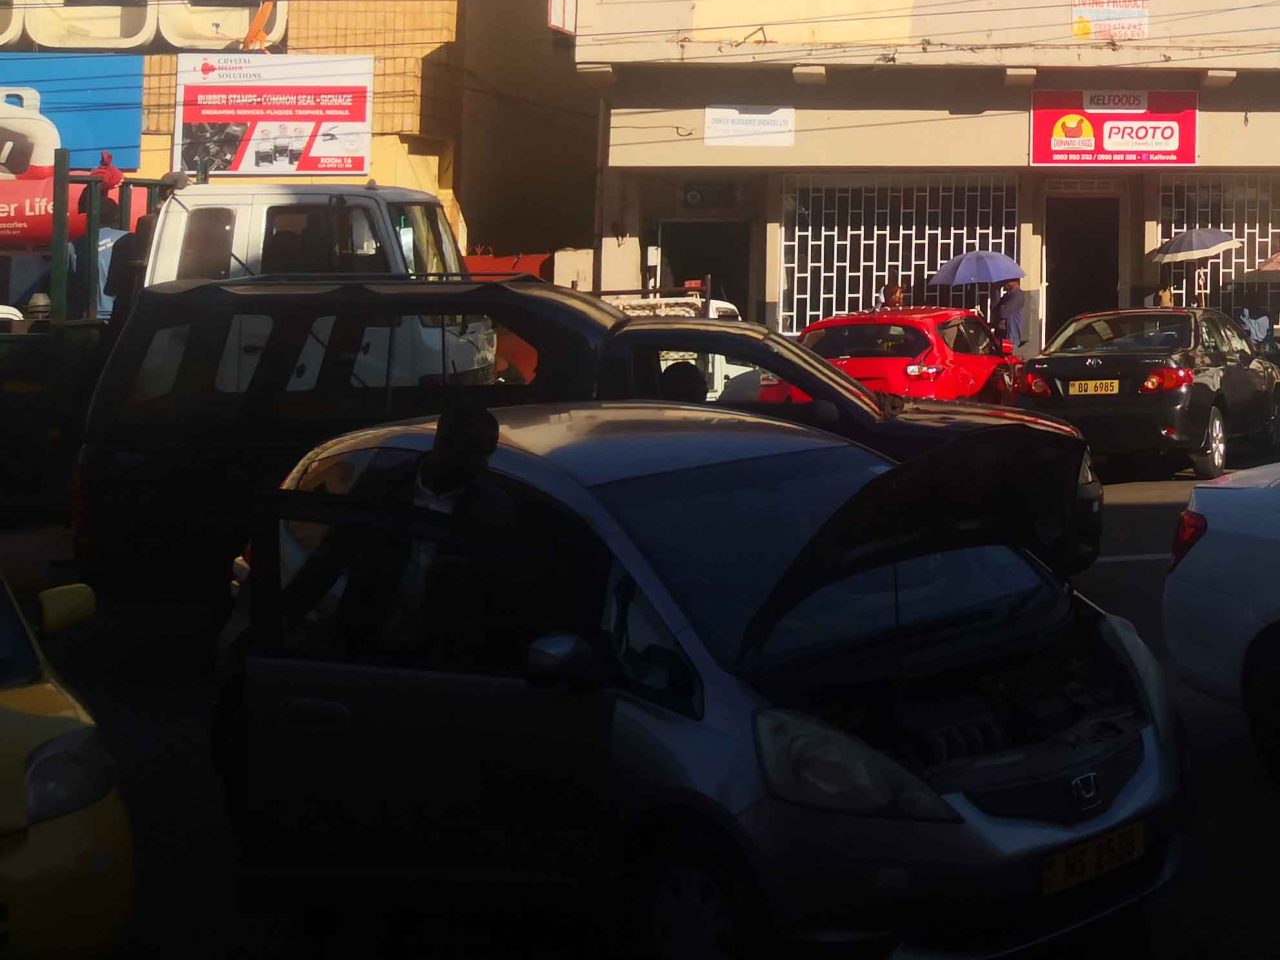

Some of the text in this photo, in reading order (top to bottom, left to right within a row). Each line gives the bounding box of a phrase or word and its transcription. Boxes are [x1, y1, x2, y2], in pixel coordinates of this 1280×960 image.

[197, 94, 353, 105] RUBBER STAMPS COMMON SEAL SIGNAGE
[1089, 94, 1141, 105] KELFOODS
[1108, 126, 1174, 140] PROTO
[1094, 382, 1115, 392] 6985
